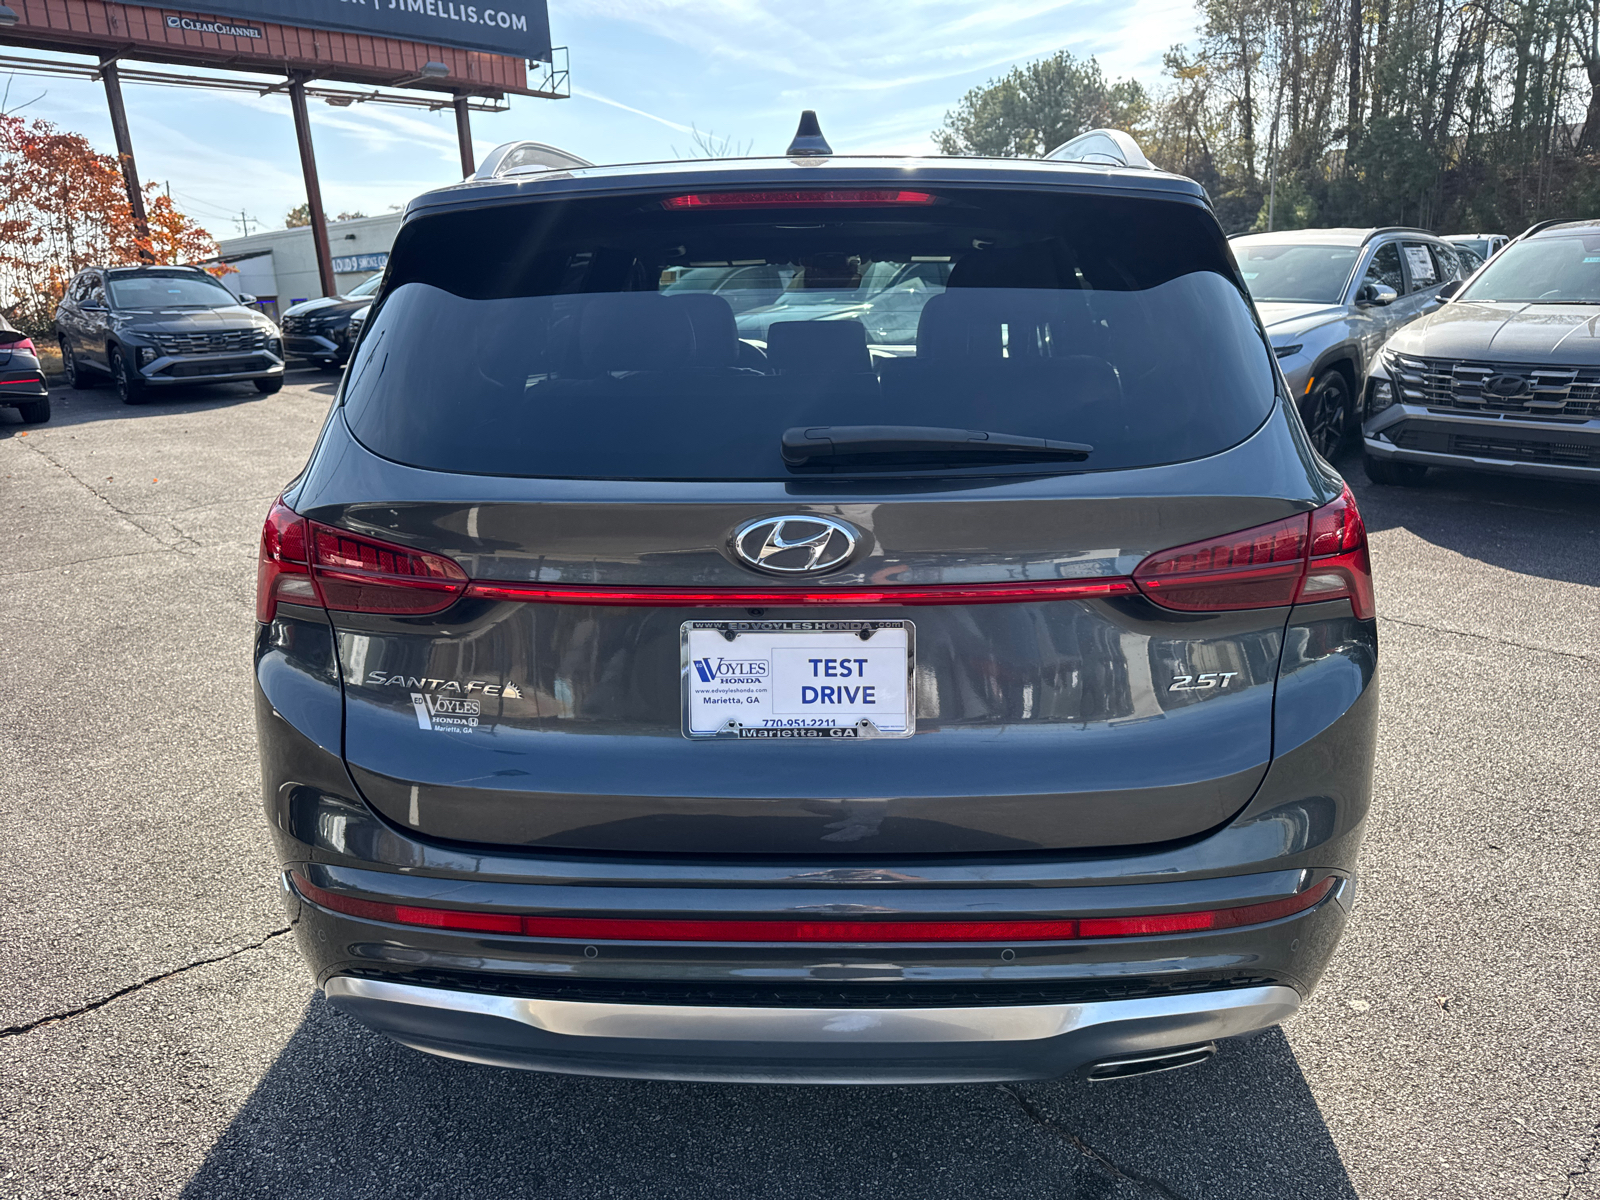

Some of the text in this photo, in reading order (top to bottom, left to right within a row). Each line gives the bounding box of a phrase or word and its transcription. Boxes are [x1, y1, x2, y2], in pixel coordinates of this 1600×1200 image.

[702, 657, 767, 681] VOYLES
[808, 658, 869, 678] TEST
[720, 677, 763, 685] HONDA
[694, 687, 768, 695] www.edvoyleshonda.com
[801, 686, 876, 705] DRIVE
[414, 693, 480, 716] ED VOYLES
[703, 696, 760, 705] Marietta, GA
[432, 716, 468, 725] HONDA
[762, 718, 837, 727] 770-951-2211
[434, 725, 462, 734] Marietta,
[742, 728, 856, 738] Marietta, GA
